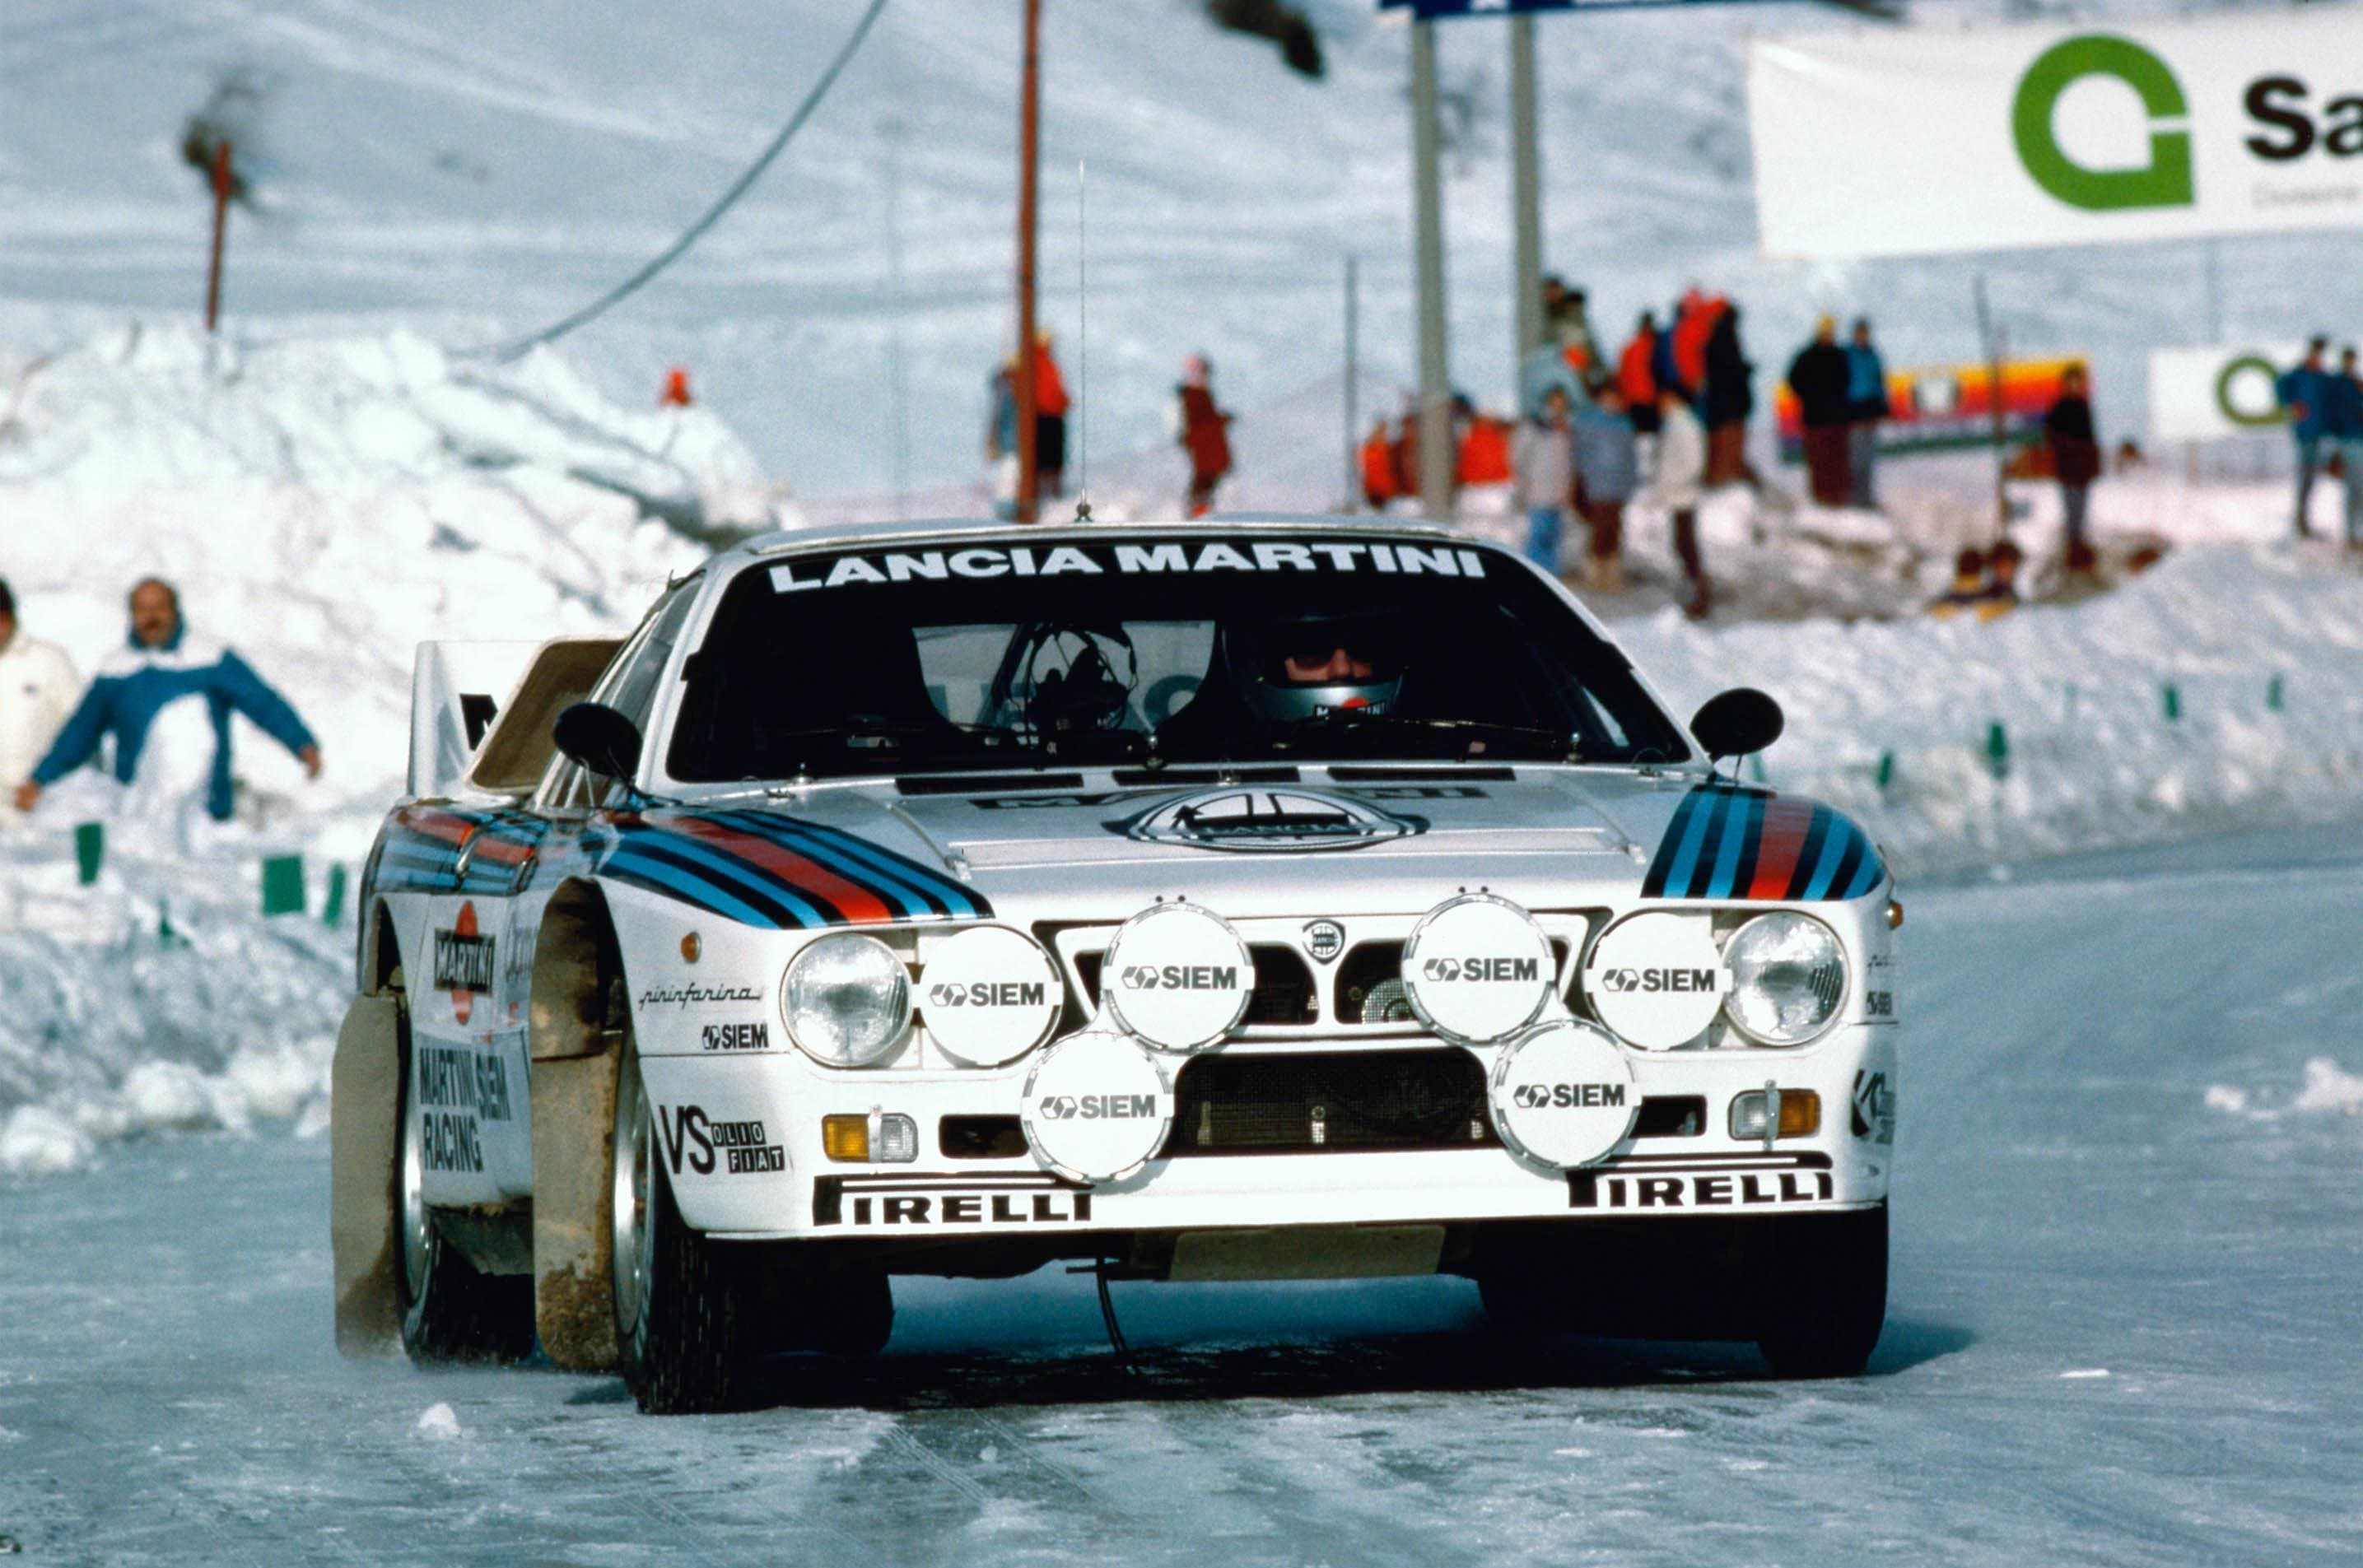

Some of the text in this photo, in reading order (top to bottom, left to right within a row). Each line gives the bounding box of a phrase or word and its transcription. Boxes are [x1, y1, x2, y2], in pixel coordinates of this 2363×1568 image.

[768, 542, 1486, 593] LANCIA MARTINI
[436, 939, 496, 988] MARTINI
[1463, 957, 1538, 982] SIEM
[1161, 965, 1237, 990] SIEM
[1642, 968, 1716, 993] SIEM
[969, 982, 1045, 1007] SIEM
[721, 1022, 769, 1049] SIEM
[420, 1048, 477, 1106] MARTINI
[1079, 1094, 1156, 1119] SIEM
[1552, 1083, 1625, 1109] SIEM
[424, 1112, 484, 1172] RACING
[659, 1105, 715, 1175] VS
[712, 1123, 763, 1144] OLIO
[729, 1148, 782, 1171] FIAT
[1565, 1151, 1833, 1208] PIRELLI
[813, 1171, 1096, 1226] PIRELLI
